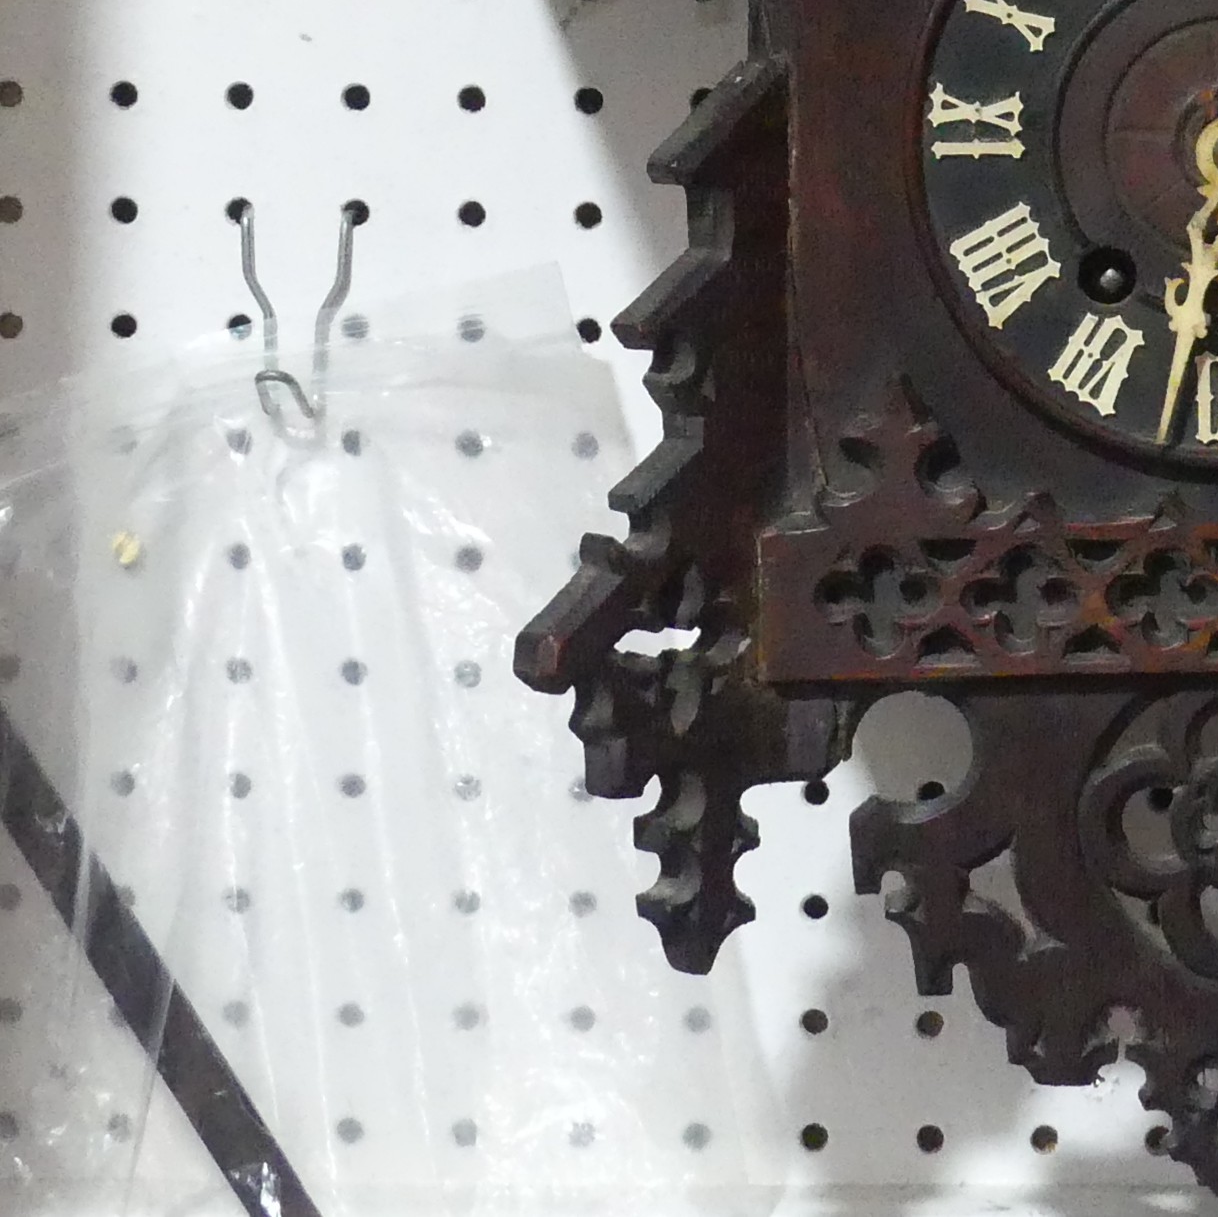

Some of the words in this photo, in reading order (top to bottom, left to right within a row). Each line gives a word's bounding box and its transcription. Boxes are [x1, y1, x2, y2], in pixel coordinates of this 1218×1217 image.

[926, 81, 1026, 160] IX
[949, 200, 1062, 330] VIII
[1046, 311, 1146, 417] VII
